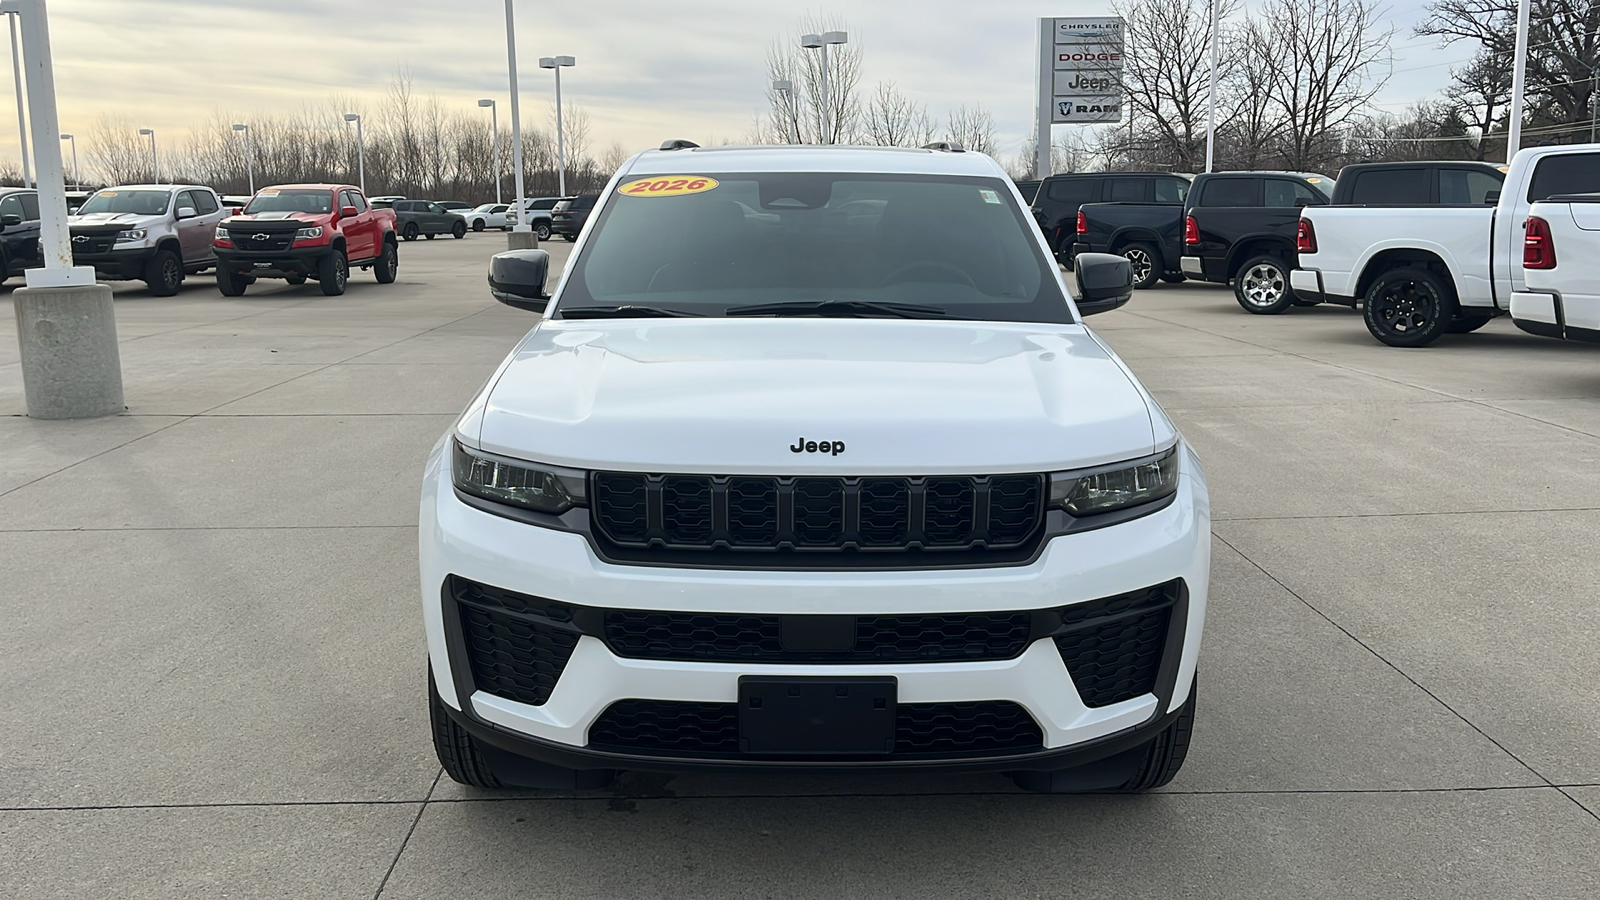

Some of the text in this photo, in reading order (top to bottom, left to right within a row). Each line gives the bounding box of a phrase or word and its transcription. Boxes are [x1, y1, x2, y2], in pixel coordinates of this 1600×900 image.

[1059, 53, 1120, 61] DODGE
[1068, 74, 1110, 91] Jeep
[1076, 105, 1118, 113] RAM
[627, 179, 709, 193] 2026
[790, 437, 845, 456] Jeep
